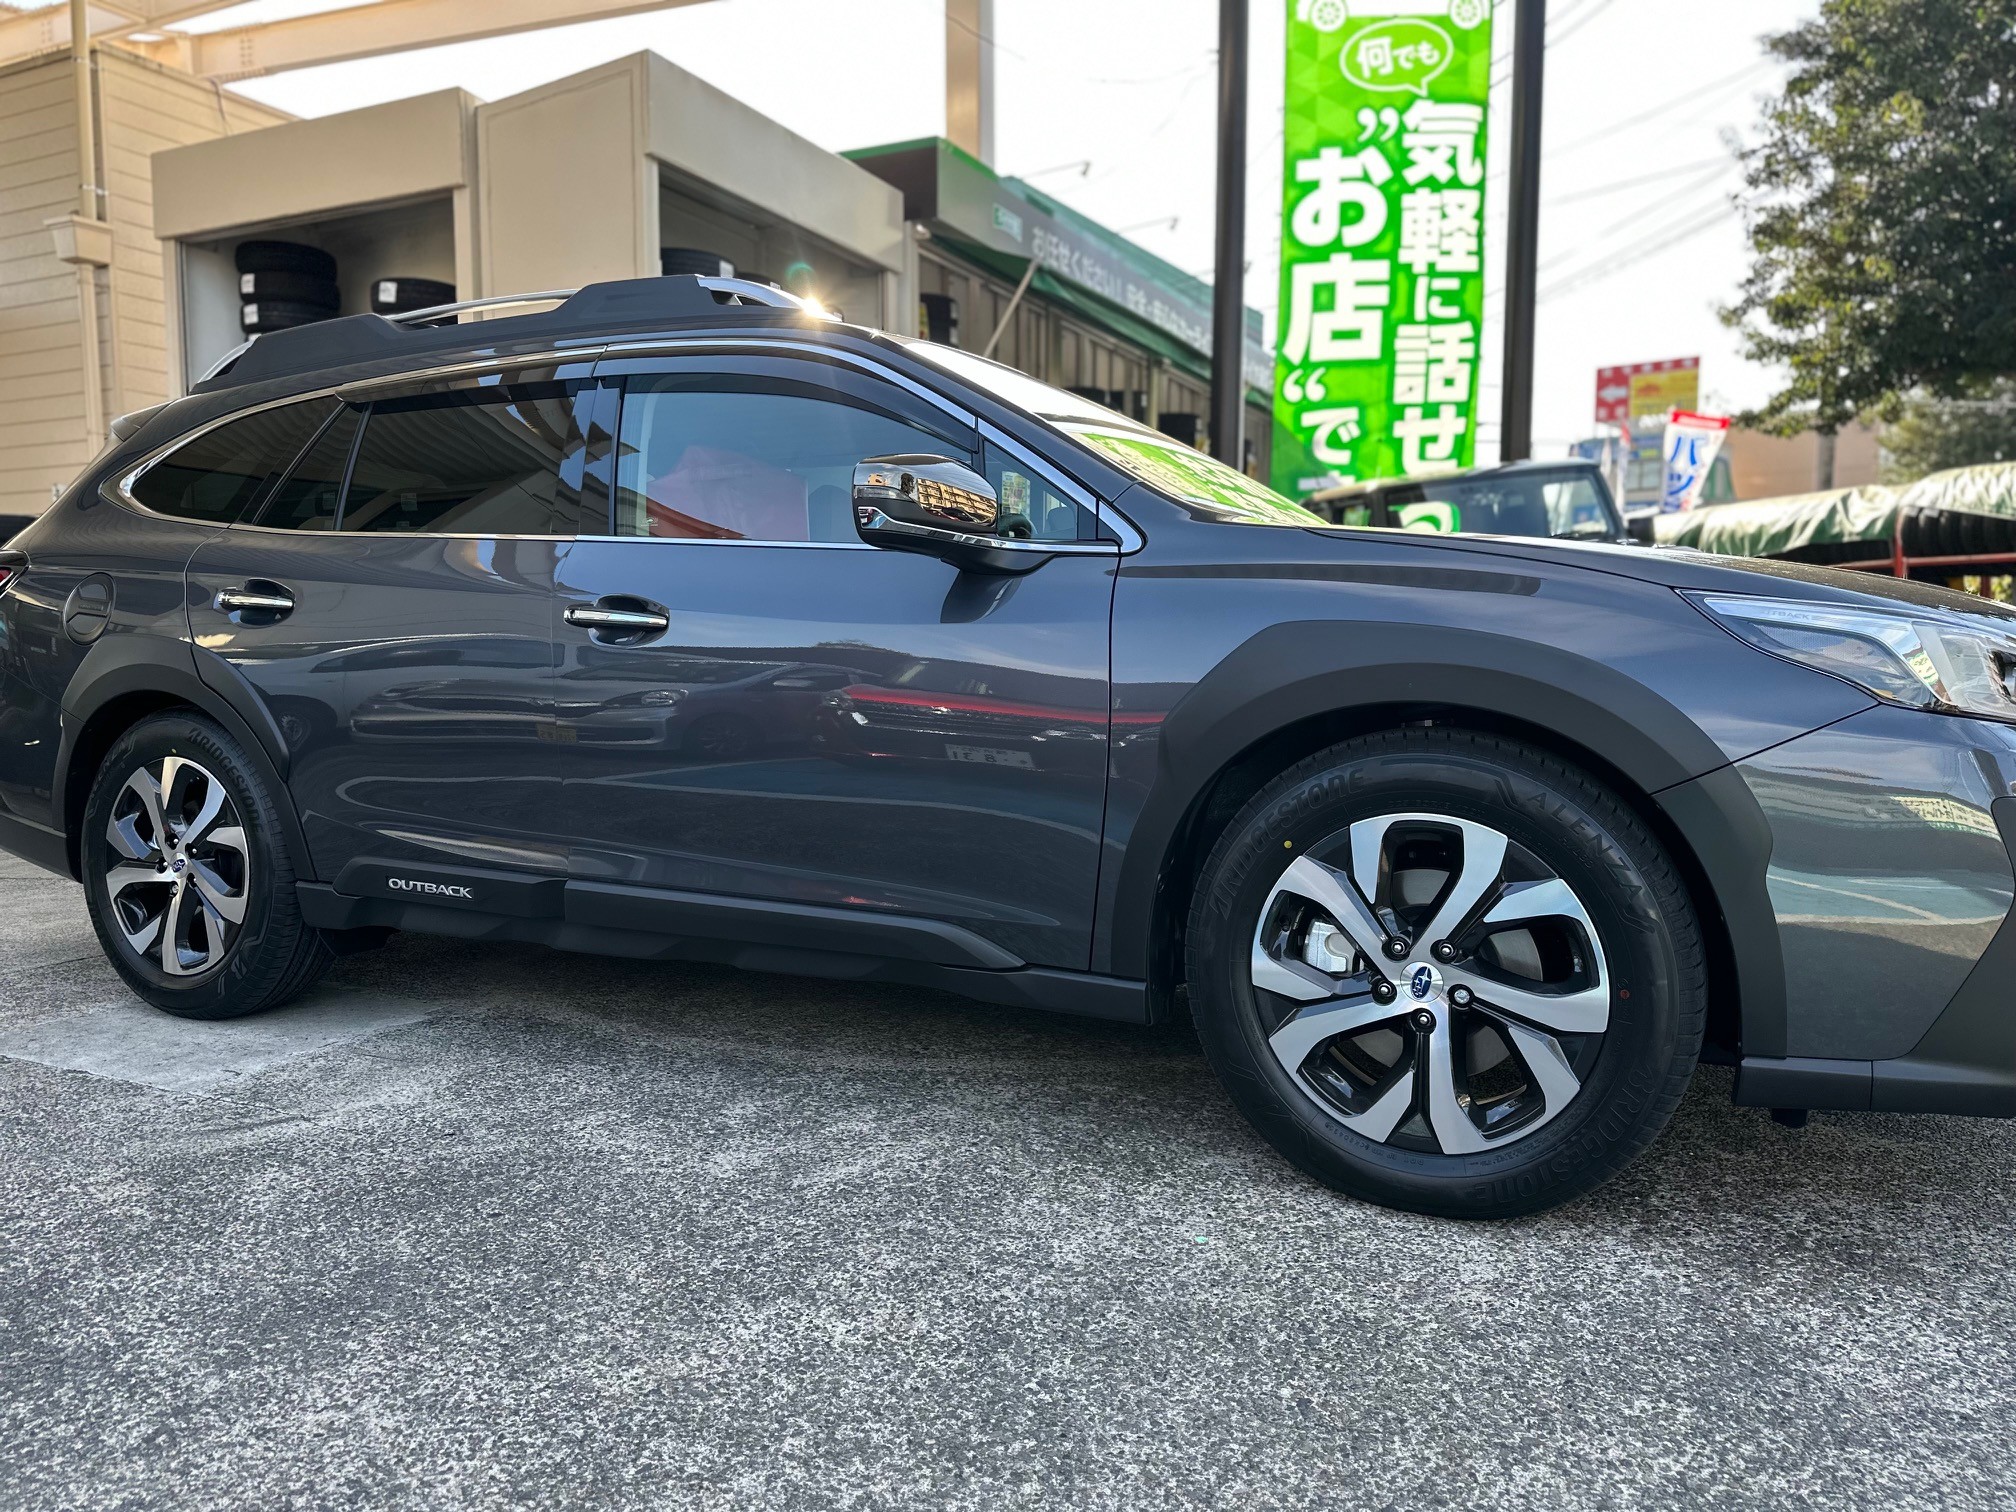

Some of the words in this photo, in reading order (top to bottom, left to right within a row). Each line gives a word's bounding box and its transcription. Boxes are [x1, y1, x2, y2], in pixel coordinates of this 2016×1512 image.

[1356, 36, 1440, 79] 何でも
[187, 727, 264, 834] BRIDGESTONE
[388, 878, 473, 899] OUTBACK
[1208, 767, 1364, 921] BRIDGESTONE
[1526, 791, 1643, 899] ALENZA
